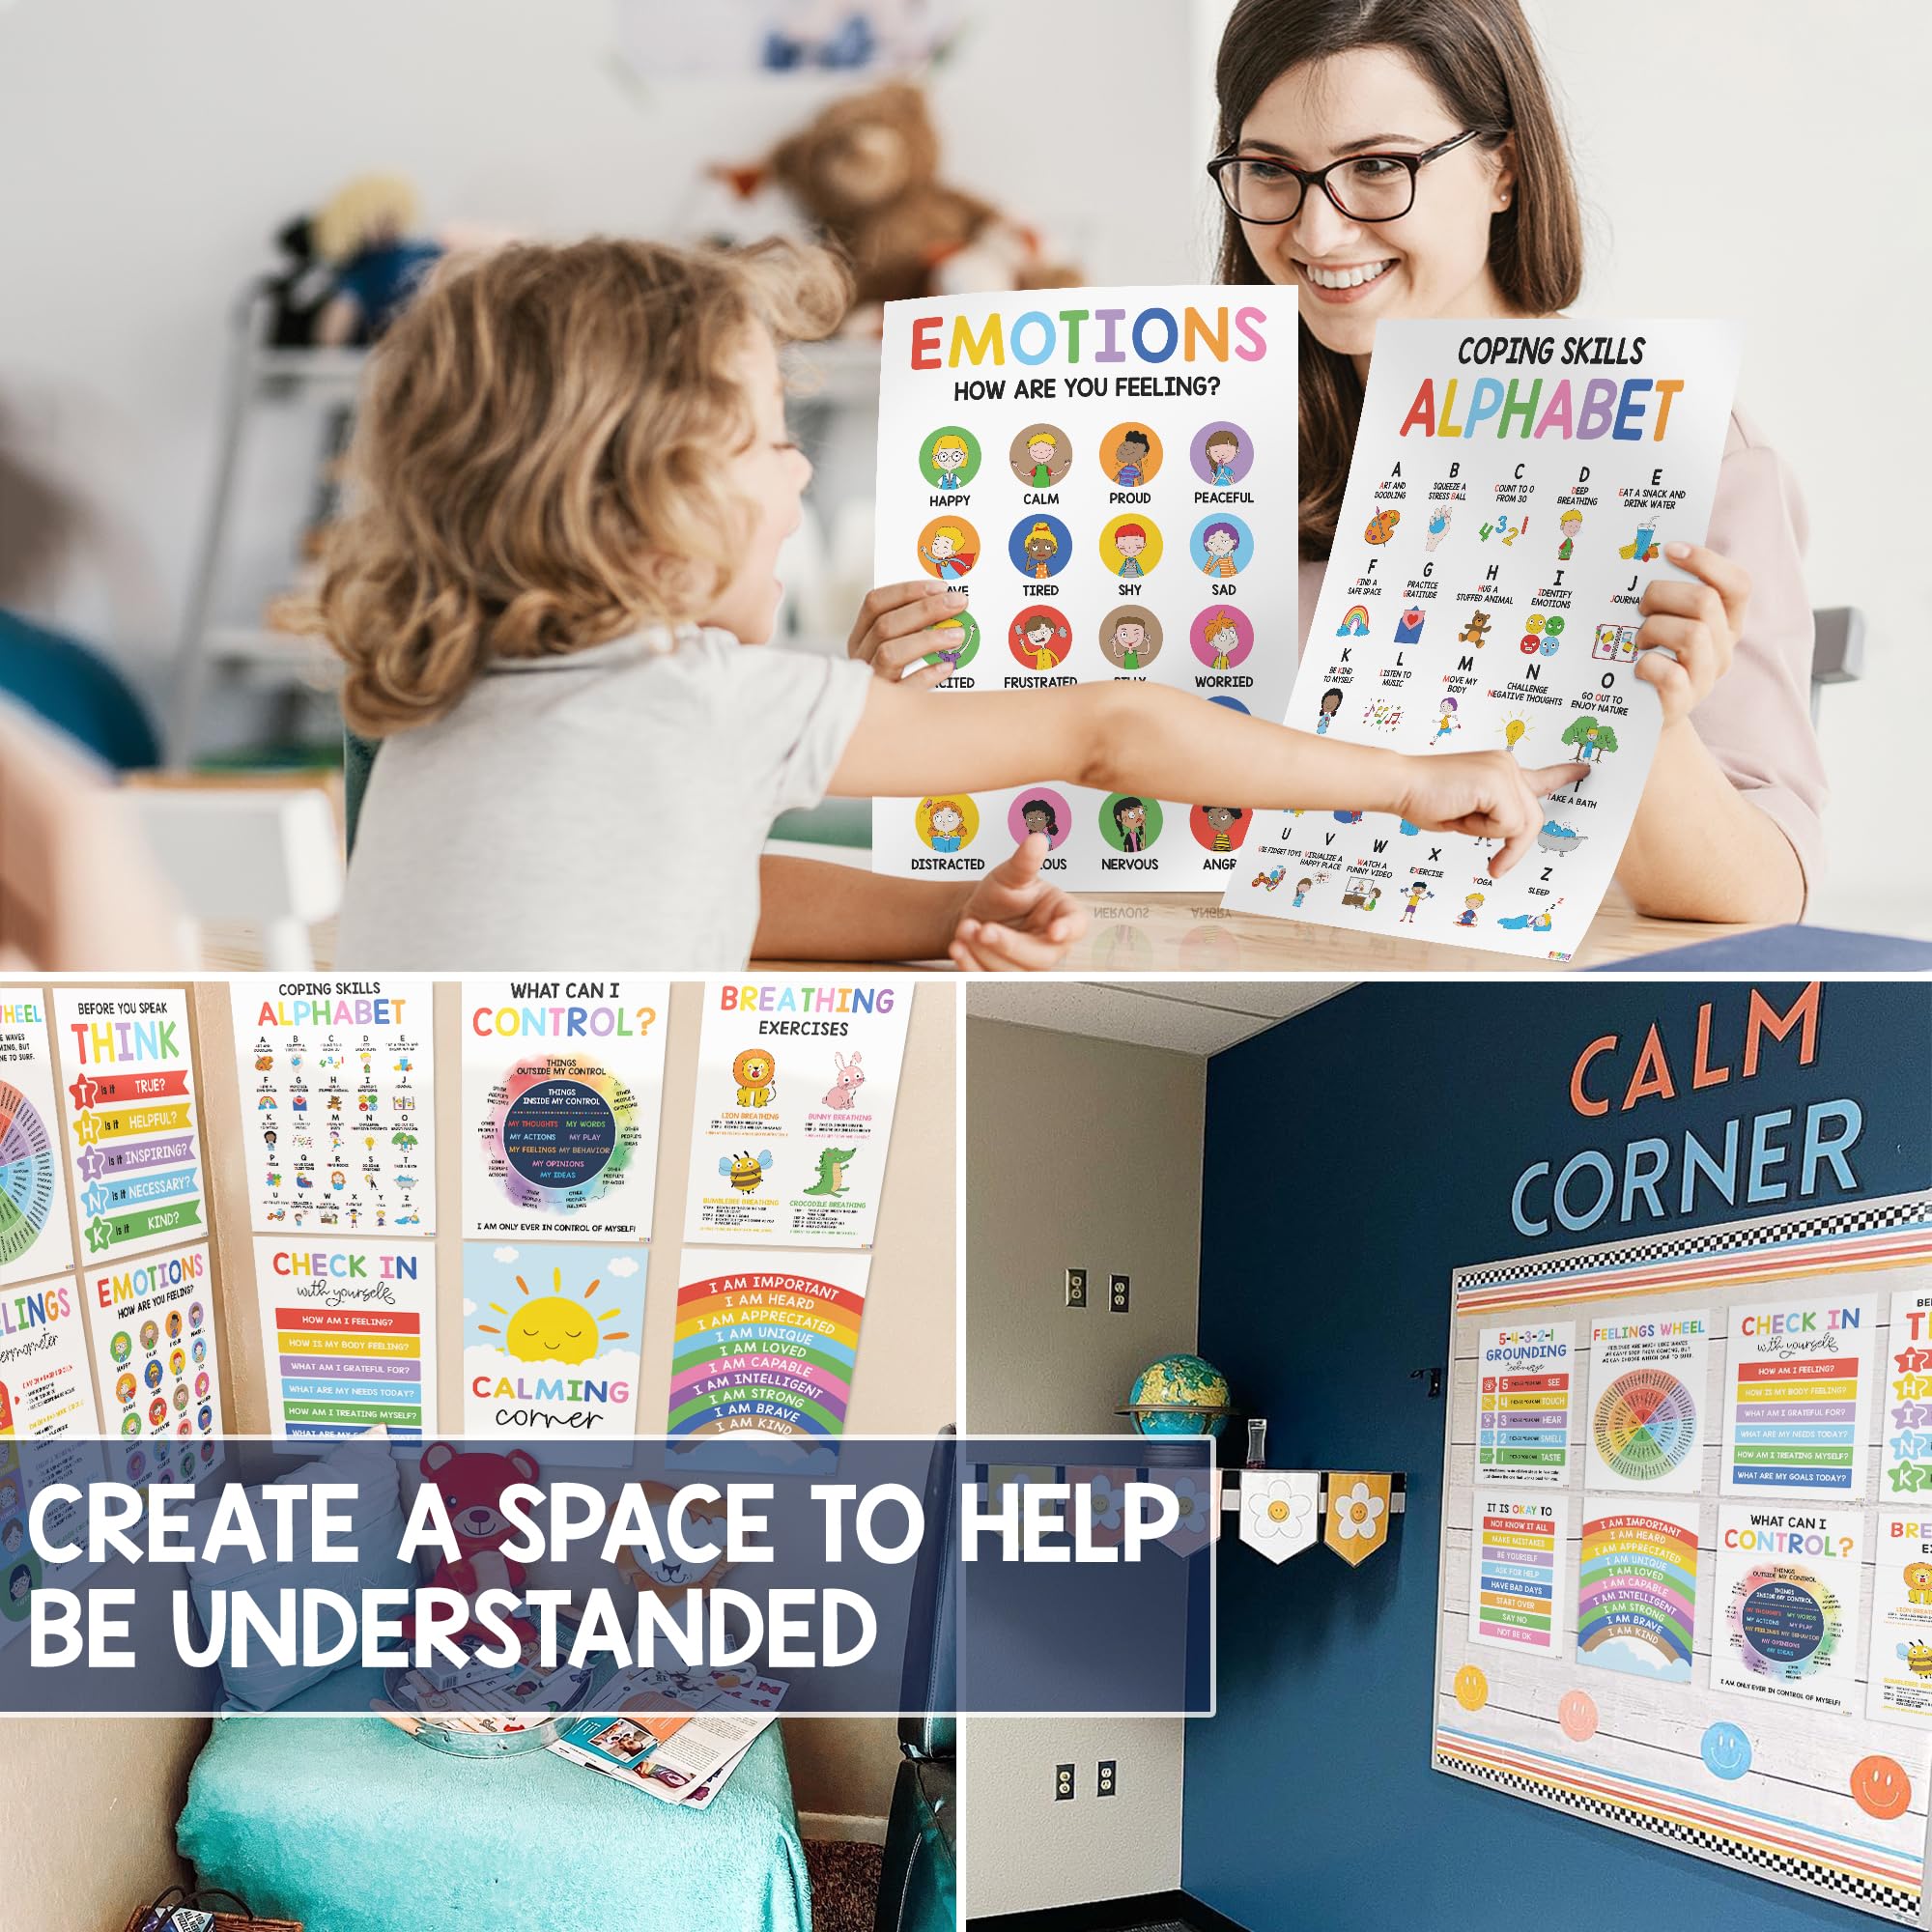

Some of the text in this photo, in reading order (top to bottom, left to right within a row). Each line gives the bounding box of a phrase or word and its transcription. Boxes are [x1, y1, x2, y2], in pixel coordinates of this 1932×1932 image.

[911, 306, 1267, 370] EMOTIONS
[1459, 337, 1646, 365] COPING SKILLS
[954, 376, 1221, 401] HOW ARE YOU FEELING?
[1400, 377, 1685, 441] ALPHABET
[1434, 482, 1460, 491] SQUEEZE
[1494, 484, 1518, 493] COUNT
[1572, 486, 1589, 495] DEEP
[1618, 488, 1633, 497] EAT
[929, 496, 970, 507] HAPPY
[1023, 493, 1060, 505] CALM
[1109, 492, 1151, 504] PROUD
[1194, 492, 1254, 503] PEACEFUL
[1374, 491, 1406, 499] DOODLING
[1428, 492, 1466, 500] STRESS BALL
[1518, 495, 1527, 503] 30
[1557, 496, 1598, 506] BREATHING
[1624, 499, 1675, 510] DRINK WATER
[1022, 585, 1059, 596] TIRED
[1118, 584, 1141, 596] SHY
[1212, 584, 1236, 596] SAD
[1407, 581, 1438, 589] PRACTICE
[1403, 590, 1437, 599] GRATITUDE
[1456, 593, 1513, 605] STUFFED ANIMAL
[1538, 588, 1573, 599] IDENTIFY
[1531, 598, 1571, 609] EMOTIONS
[1004, 676, 1077, 689] FRUSTRATED
[1195, 676, 1254, 689] WORRIED
[1507, 682, 1548, 695] CHALLENGE
[1488, 689, 1562, 706] NEGATIVE THOUGHTS
[1581, 692, 1623, 704] GO OUT TO
[1571, 699, 1629, 716] ENJOY NATURE
[1548, 793, 1597, 810] TAKE A BATH
[911, 859, 984, 870] DISTRACTED
[1102, 859, 1158, 870] NERVOUS
[1203, 859, 1236, 870] ANGR
[1409, 867, 1443, 878] EXERCISE
[279, 982, 381, 996] COPING SKILLS
[511, 982, 619, 999] WHAT CAN I
[721, 985, 895, 1013] BREATHING
[78, 1002, 167, 1014] BEFORE YOU SPEAK
[258, 999, 406, 1027] ALPHABET
[473, 1008, 656, 1037] CONTROL?
[759, 1020, 848, 1037] EXERCISES
[71, 1021, 180, 1065] THINK
[1570, 981, 1821, 1117] CALM
[135, 1079, 165, 1092] TRUE?
[128, 1111, 177, 1128] HELPFUL?
[125, 1143, 187, 1165] INSPIRING?
[1511, 1098, 1861, 1237] CORNER
[128, 1177, 189, 1198] NECESSARY?
[148, 1212, 180, 1229] KIND?
[273, 1252, 417, 1280] CHECK IN
[98, 1254, 203, 1308] EMOTIONS
[708, 1276, 839, 1300] I AM IMPORTANT
[298, 1279, 395, 1306] with yourself
[352, 1318, 393, 1326] FEELING?
[697, 1310, 836, 1334] I AM APPRECIATED
[1742, 1308, 1860, 1336] CHECK IN
[716, 1327, 814, 1345] I AM UNIQUE
[1499, 1328, 1554, 1344] 5-4-3-2-1
[1593, 1321, 1705, 1341] FEELINGS WHEEL
[1757, 1332, 1839, 1359] with yourself
[1486, 1345, 1567, 1361] GROUNDING
[472, 1376, 629, 1404] CALMING
[693, 1372, 824, 1399] I AM INTELLIGENT
[709, 1388, 805, 1407] I AM STRONG
[1542, 1397, 1565, 1406] TOUCH
[496, 1406, 603, 1430] corner
[1541, 1435, 1562, 1443] SMELL
[1541, 1453, 1561, 1462] TASTE
[1487, 1503, 1552, 1516] IT IS OKAY TO
[1609, 1519, 1623, 1527] AM
[1626, 1518, 1681, 1537] IMPORTANT
[1750, 1515, 1827, 1529] WHAT CAN I
[1725, 1529, 1854, 1557] CONTROL?
[1492, 1580, 1542, 1595] HAVE BAD DAYS
